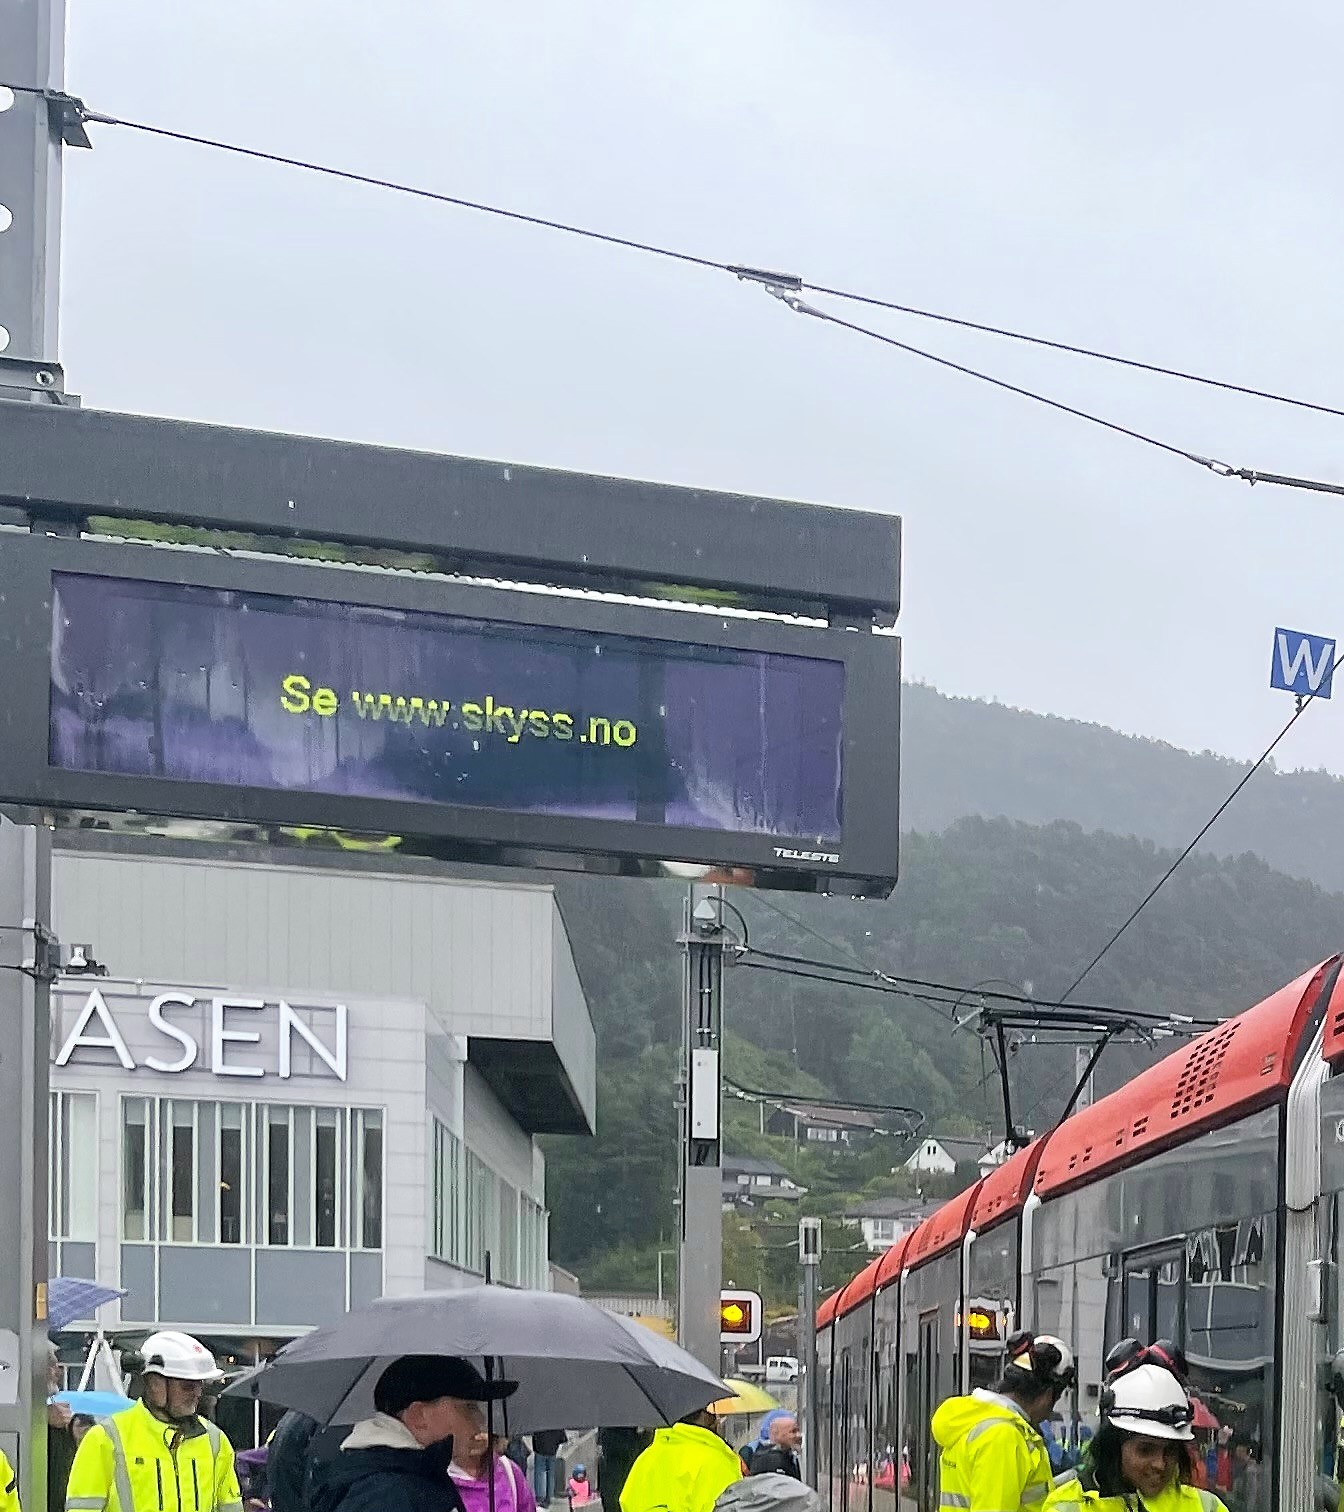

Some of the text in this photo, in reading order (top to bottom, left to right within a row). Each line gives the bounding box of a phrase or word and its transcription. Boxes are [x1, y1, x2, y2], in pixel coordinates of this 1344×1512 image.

[1277, 633, 1335, 691] W
[281, 674, 638, 748] Se www.skyss.no
